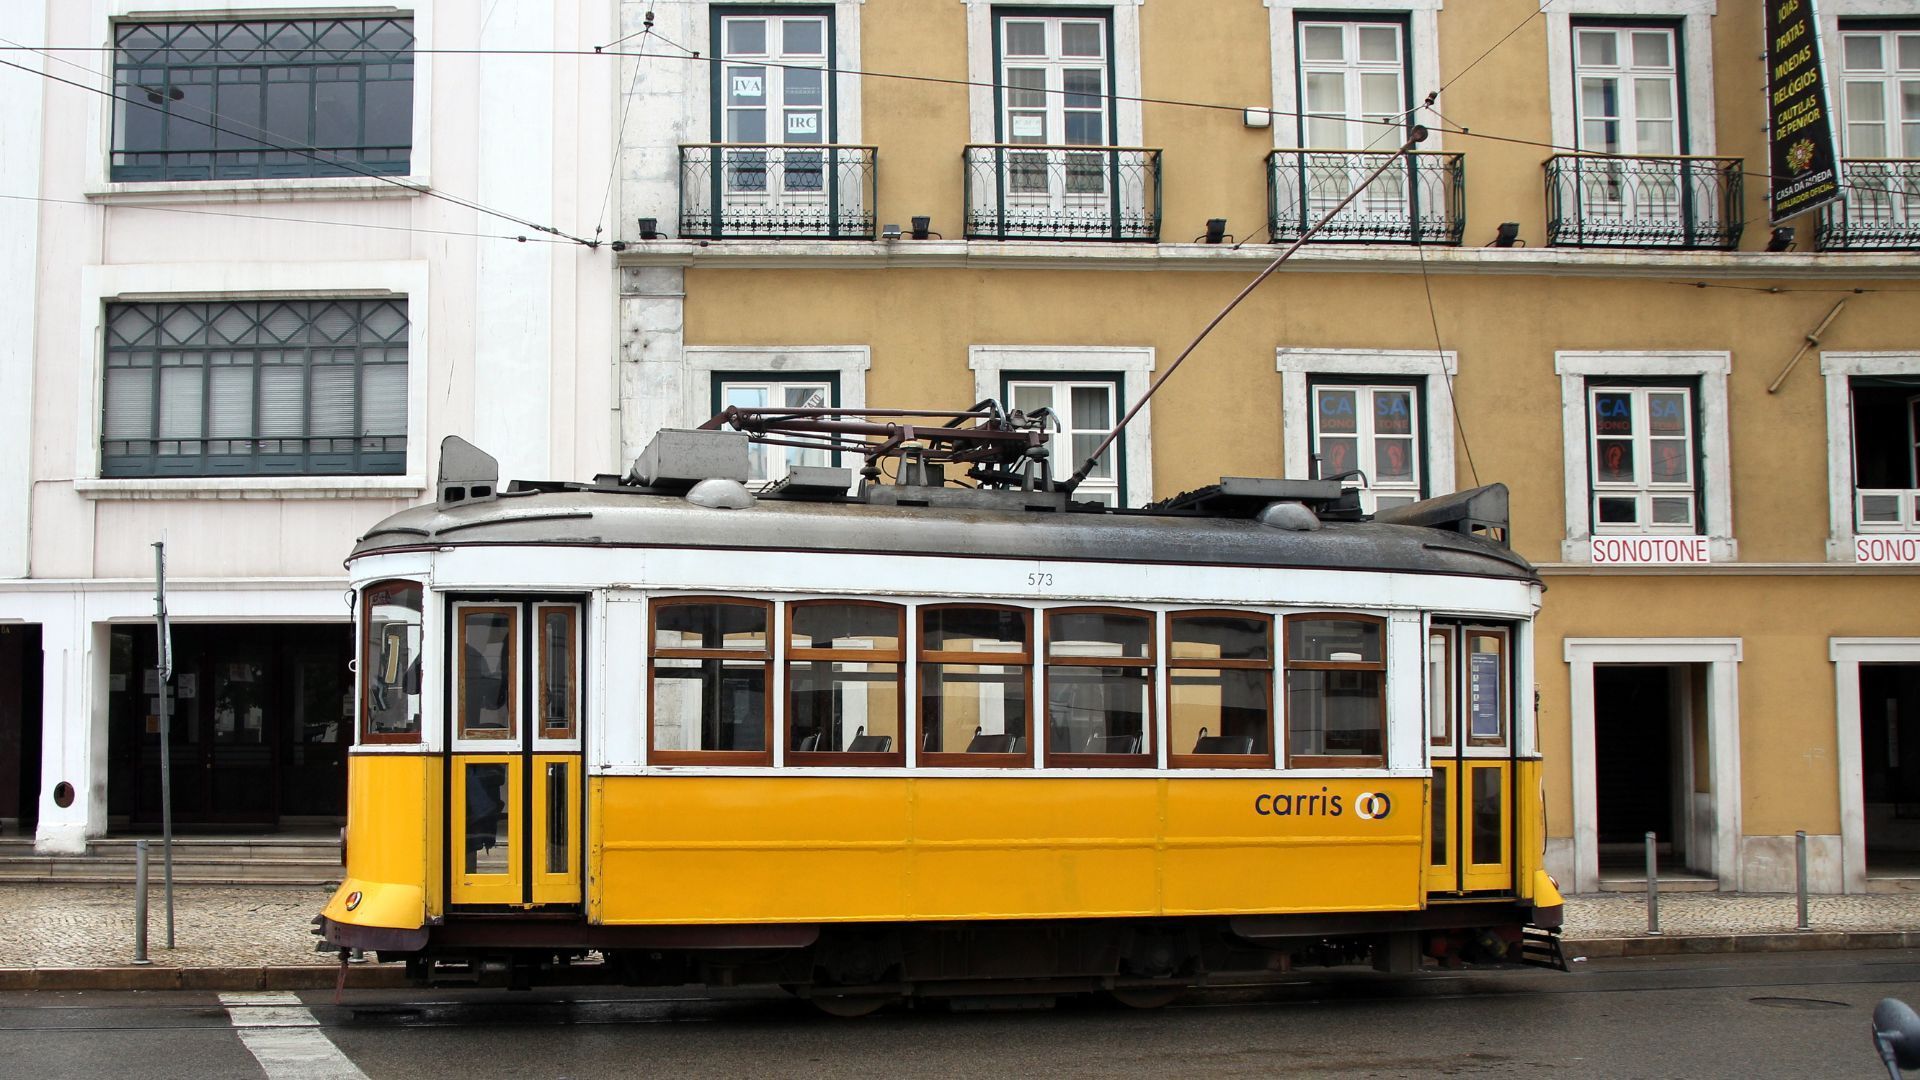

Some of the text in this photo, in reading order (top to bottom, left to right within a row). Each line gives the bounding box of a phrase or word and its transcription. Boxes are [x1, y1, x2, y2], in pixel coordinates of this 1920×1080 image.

[1776, 19, 1805, 52] PRATAS
[1775, 45, 1811, 80] MOEDAS
[734, 79, 761, 92] IVA
[1774, 67, 1817, 106] RELÓGIOS
[789, 116, 816, 129] IRC
[1777, 108, 1820, 140] DE PENHOR
[1778, 94, 1816, 124] CAUTELAS
[1776, 169, 1832, 200] CASA DA MOEDA
[1321, 396, 1407, 416] CA SA
[1597, 398, 1681, 417] CA SA
[1593, 539, 1708, 562] SONOTONE
[1028, 572, 1053, 586] 573
[1255, 786, 1343, 817] carris
